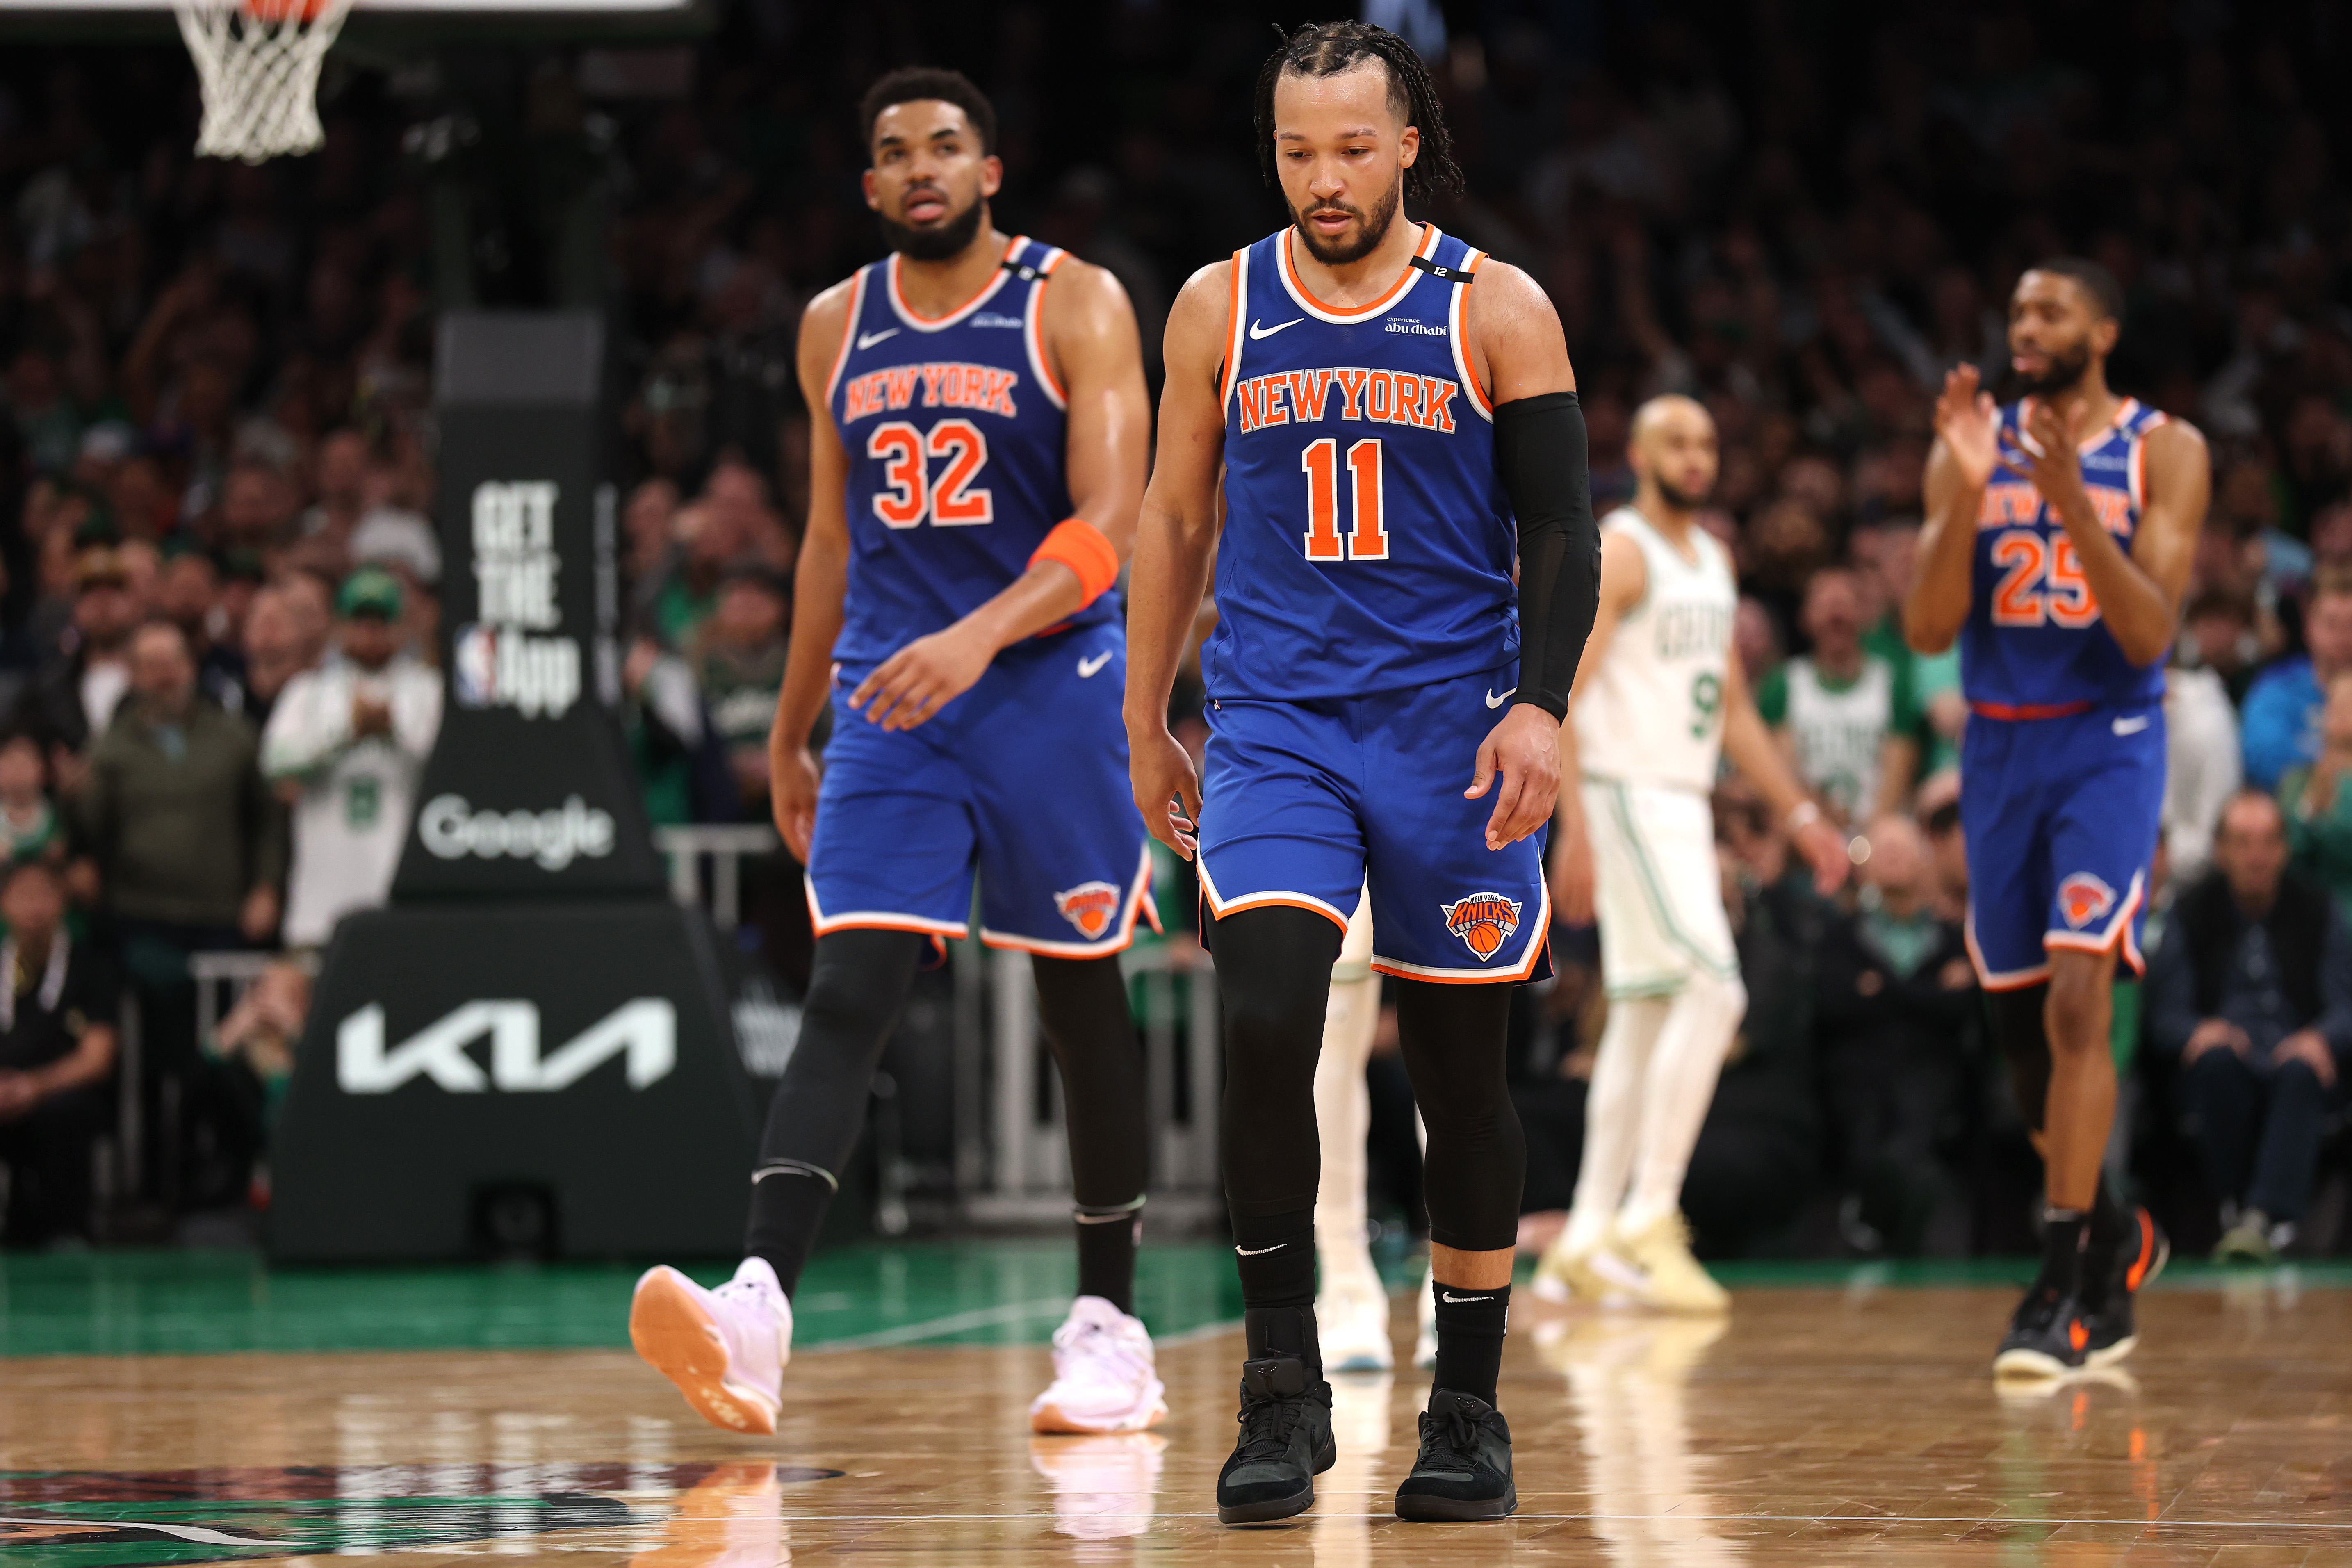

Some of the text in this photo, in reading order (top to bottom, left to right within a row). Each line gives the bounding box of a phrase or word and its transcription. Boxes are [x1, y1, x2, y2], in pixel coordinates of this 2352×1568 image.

[1433, 266, 1447, 277] 12
[1385, 322, 1447, 336] abu dhabi
[843, 362, 1019, 424] NEW YORK
[1237, 367, 1459, 435] NEW YORK
[867, 418, 994, 529] 32
[1301, 438, 1389, 561] 11
[472, 480, 559, 549] GET
[472, 550, 561, 629] THE
[1991, 530, 2103, 629] 25
[1687, 668, 1725, 741] 9
[418, 792, 615, 872] Google
[1448, 900, 1517, 928] KNICKS
[1470, 895, 1483, 903] NEW
[336, 997, 677, 1094] KIA
